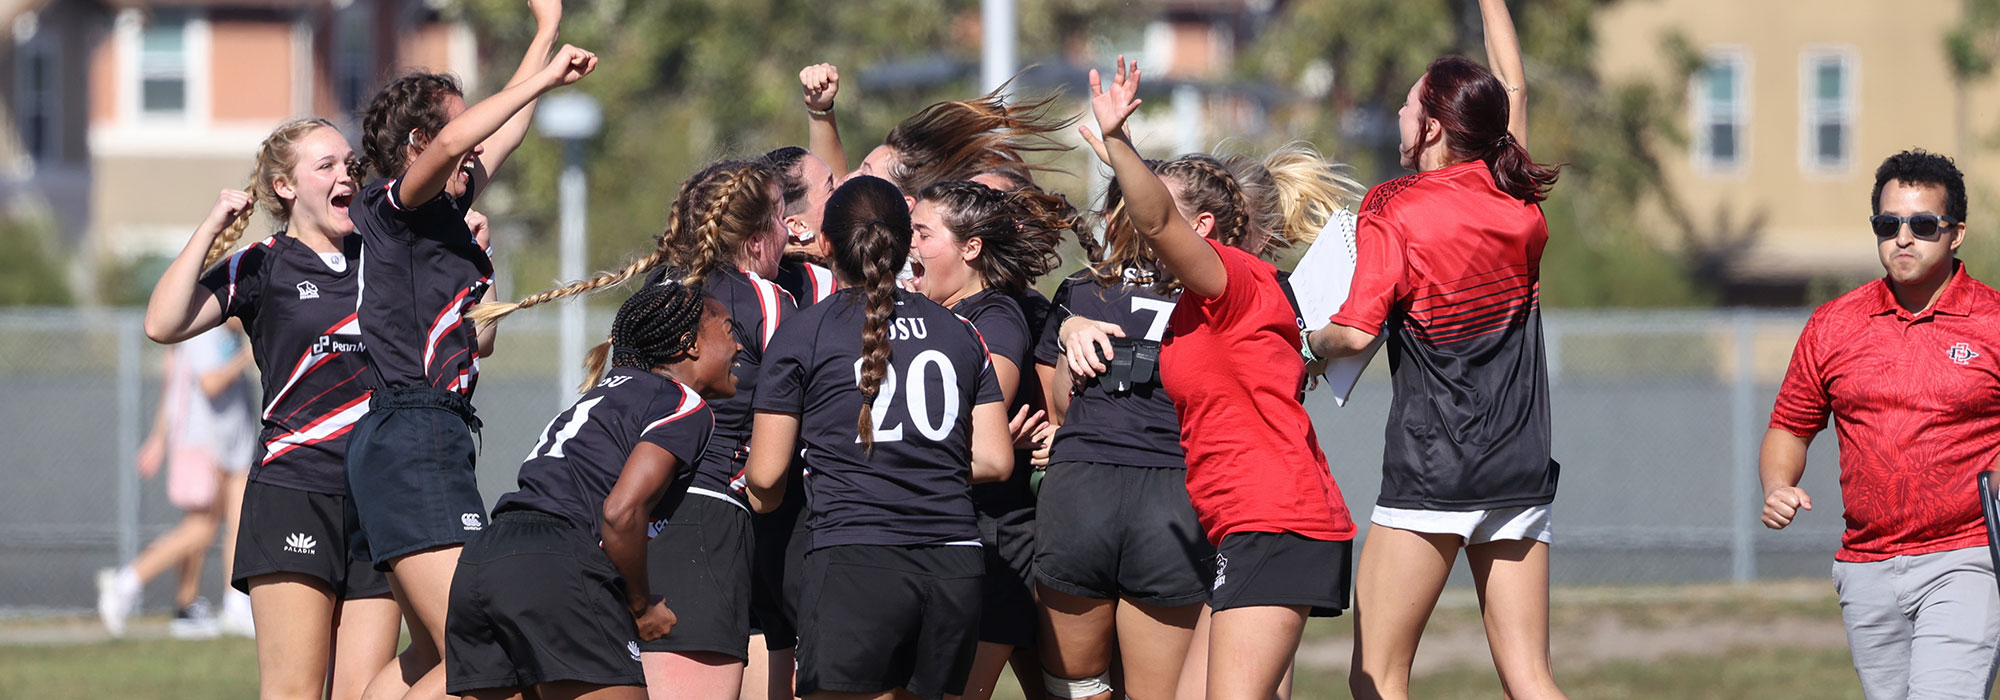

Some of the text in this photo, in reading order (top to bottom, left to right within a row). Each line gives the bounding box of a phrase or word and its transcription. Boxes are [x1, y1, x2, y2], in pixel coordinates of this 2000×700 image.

[1130, 296, 1177, 342] 7
[332, 341, 357, 353] Penn
[853, 349, 960, 444] 20
[283, 545, 316, 555] PALADIN
